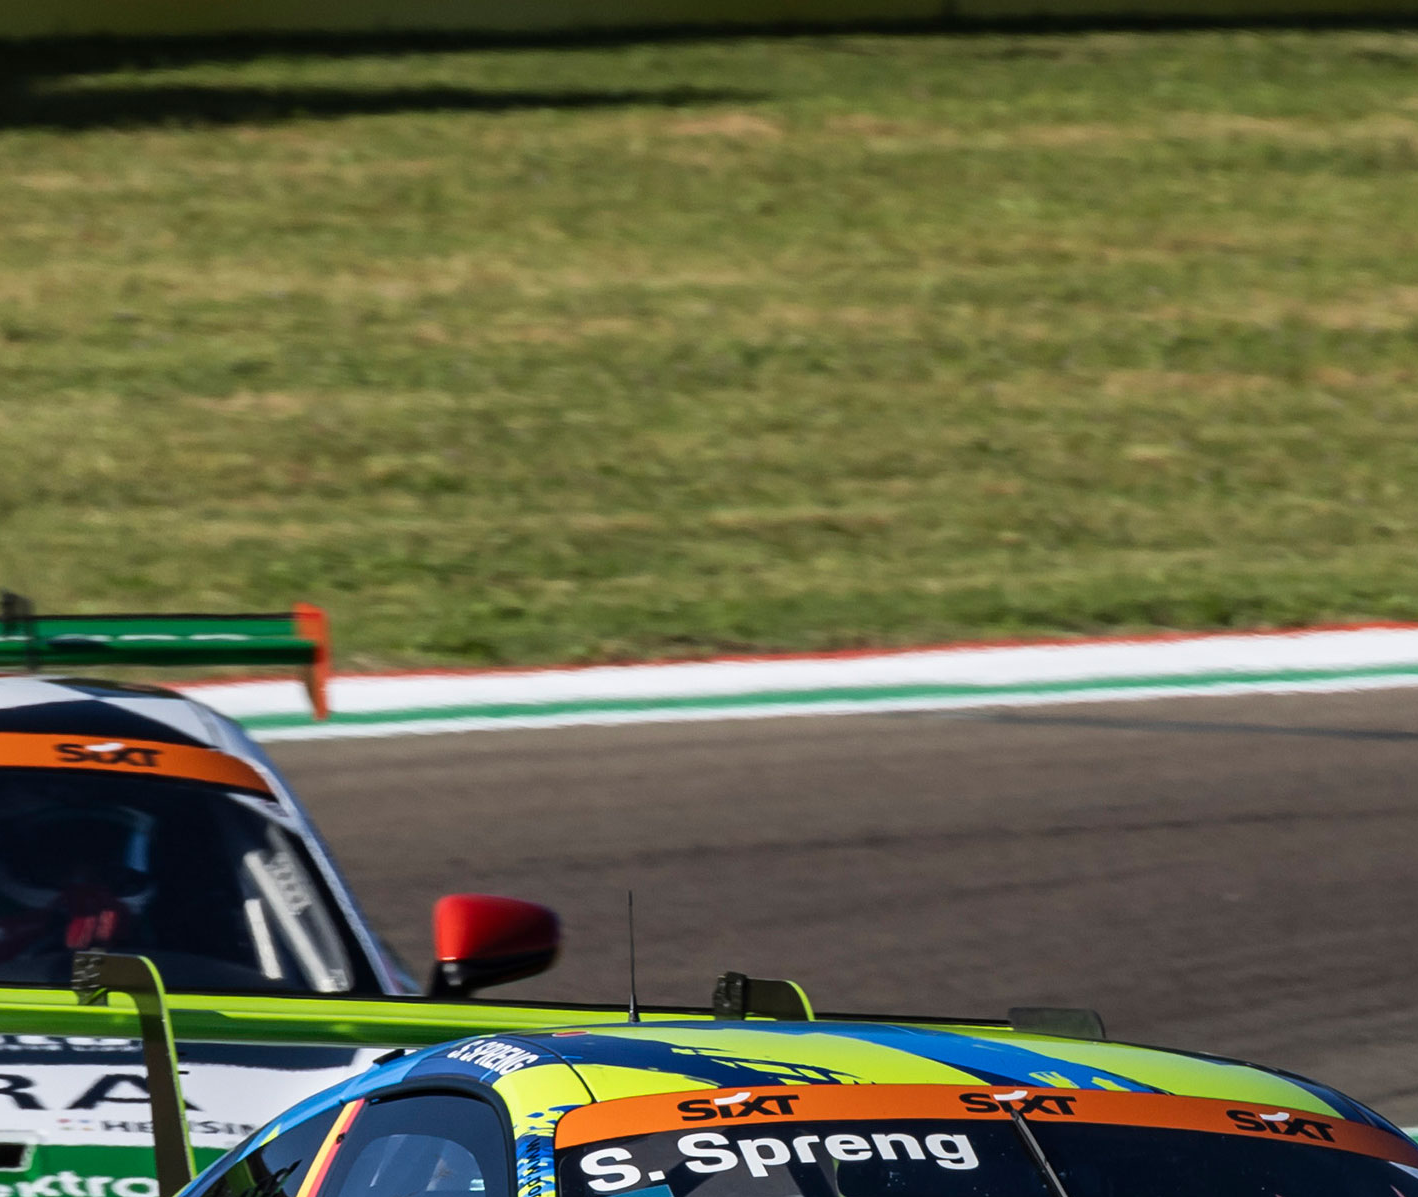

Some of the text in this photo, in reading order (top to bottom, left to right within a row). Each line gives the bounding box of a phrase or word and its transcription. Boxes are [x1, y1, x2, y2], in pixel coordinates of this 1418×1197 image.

[459, 1041, 539, 1076] SPRENG
[580, 1132, 979, 1192] S. Spreng
